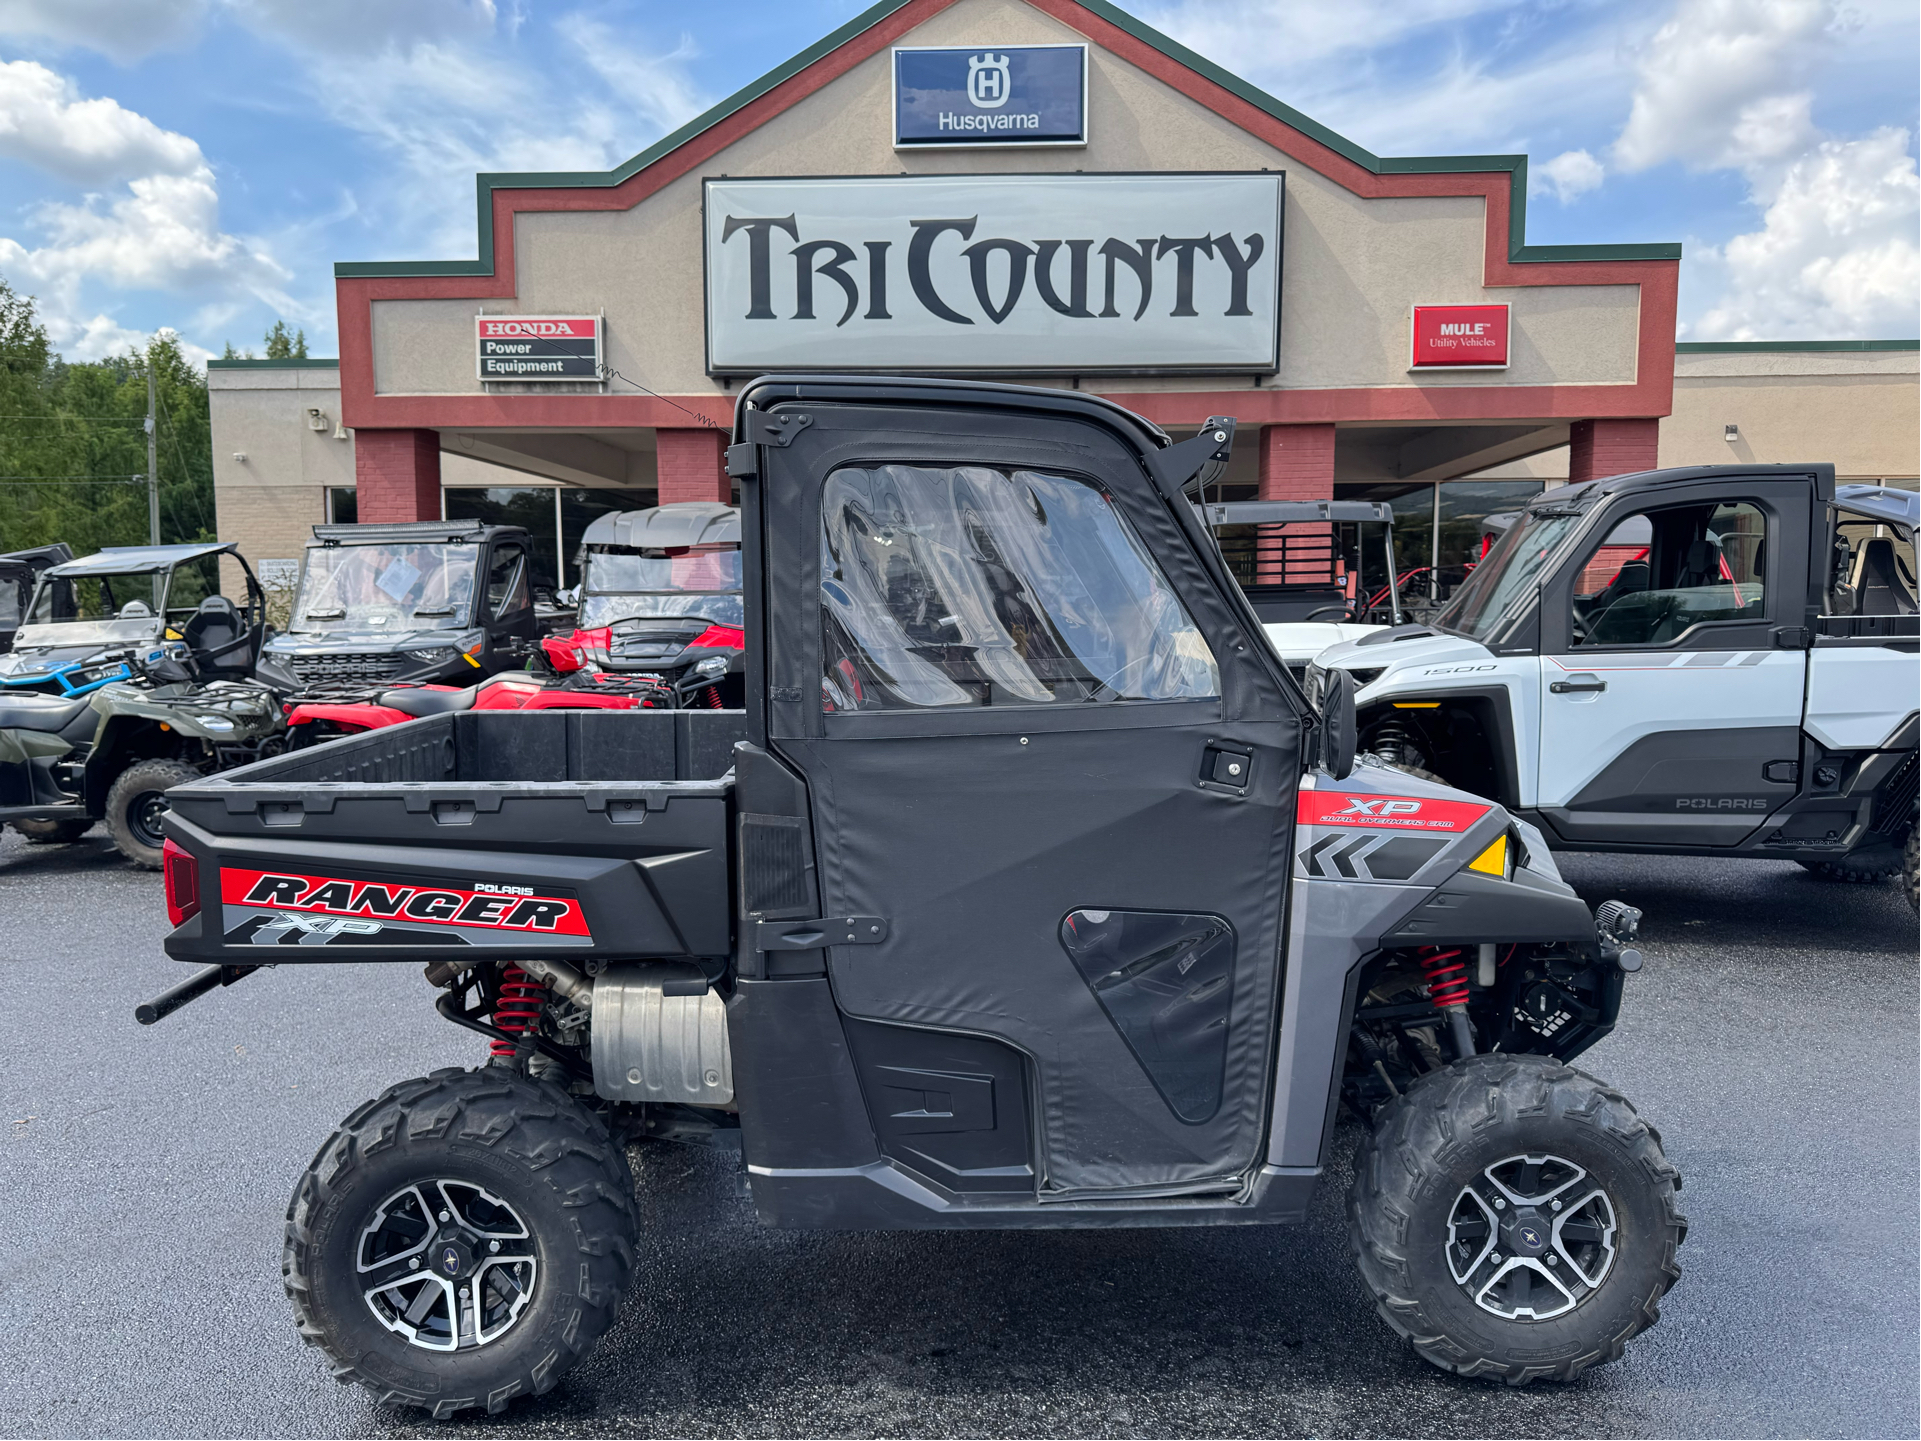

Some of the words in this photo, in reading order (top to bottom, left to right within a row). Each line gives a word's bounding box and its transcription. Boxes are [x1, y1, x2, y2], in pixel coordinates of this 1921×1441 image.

[938, 111, 1039, 132] Husqvarna
[486, 323, 574, 335] HONDA
[486, 342, 531, 354] Power
[1429, 338, 1458, 349] Utility
[1460, 337, 1496, 347] Vehicles
[487, 360, 563, 374] Equipment
[461, 635, 481, 647] 1000
[308, 663, 378, 674] POLARIS
[1423, 665, 1498, 675] 1500
[1332, 797, 1422, 816] XP
[1676, 798, 1767, 809] POLARIS
[1320, 815, 1356, 823] DUAL
[1358, 817, 1426, 826] OVERHEAD
[1427, 820, 1455, 828] CAM
[474, 883, 534, 896] POLARIS
[243, 874, 570, 929] RANGER
[257, 912, 384, 935] XP
